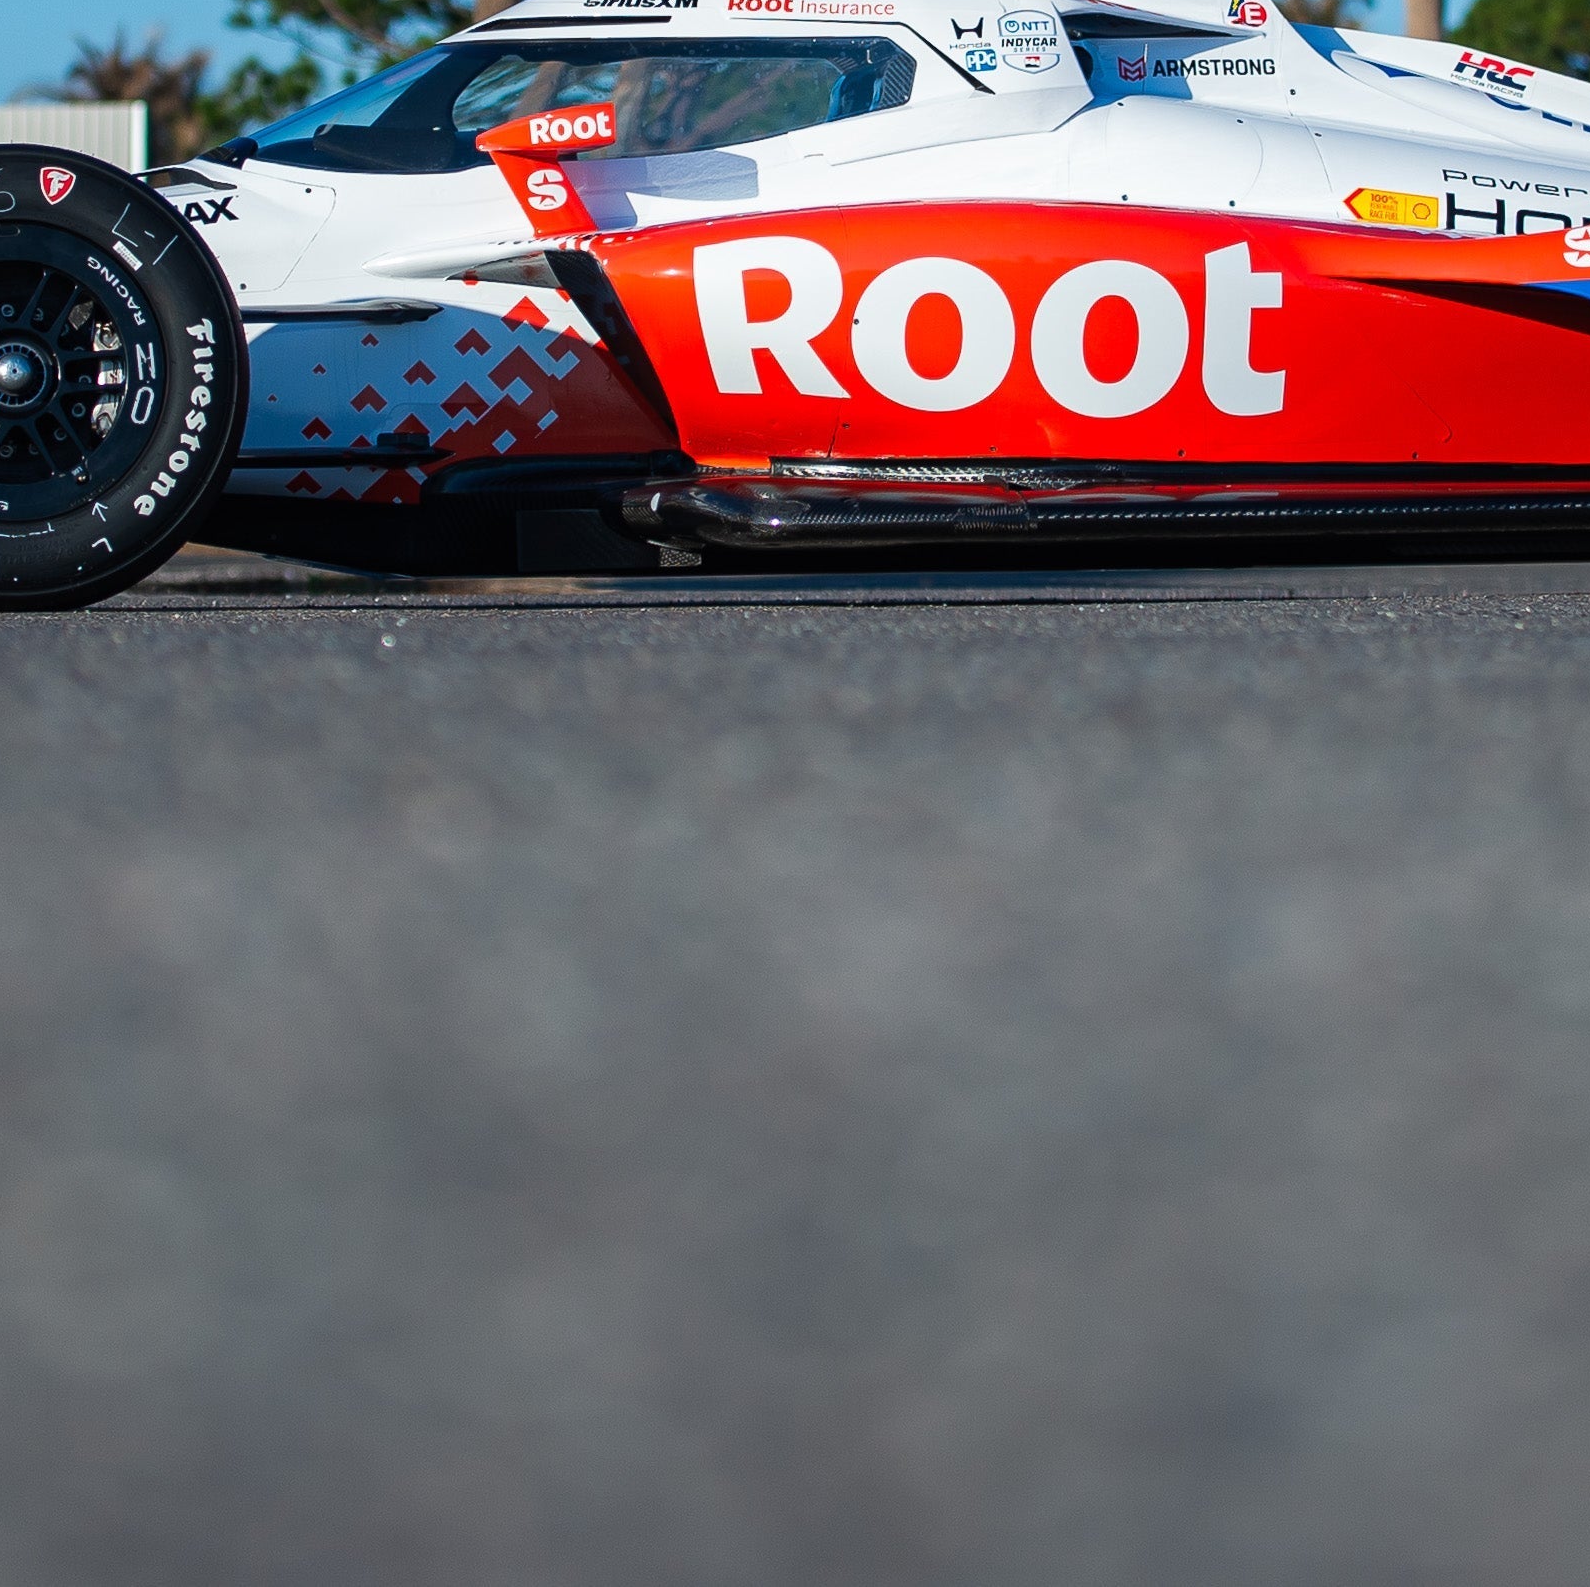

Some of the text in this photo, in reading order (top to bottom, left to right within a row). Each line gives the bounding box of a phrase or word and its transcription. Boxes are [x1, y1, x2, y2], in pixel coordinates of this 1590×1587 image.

[801, 0, 894, 16] Insurance
[1022, 21, 1049, 31] NTT
[1001, 38, 1057, 47] INDYCAR
[967, 51, 996, 71] PPG
[1153, 58, 1276, 77] ARMSTRONG
[1454, 52, 1535, 92] HRC
[529, 111, 611, 145] Root
[1371, 193, 1398, 204] 100%
[86, 256, 146, 325] RACING
[693, 236, 1287, 418] Root
[134, 318, 215, 516] Firestone
